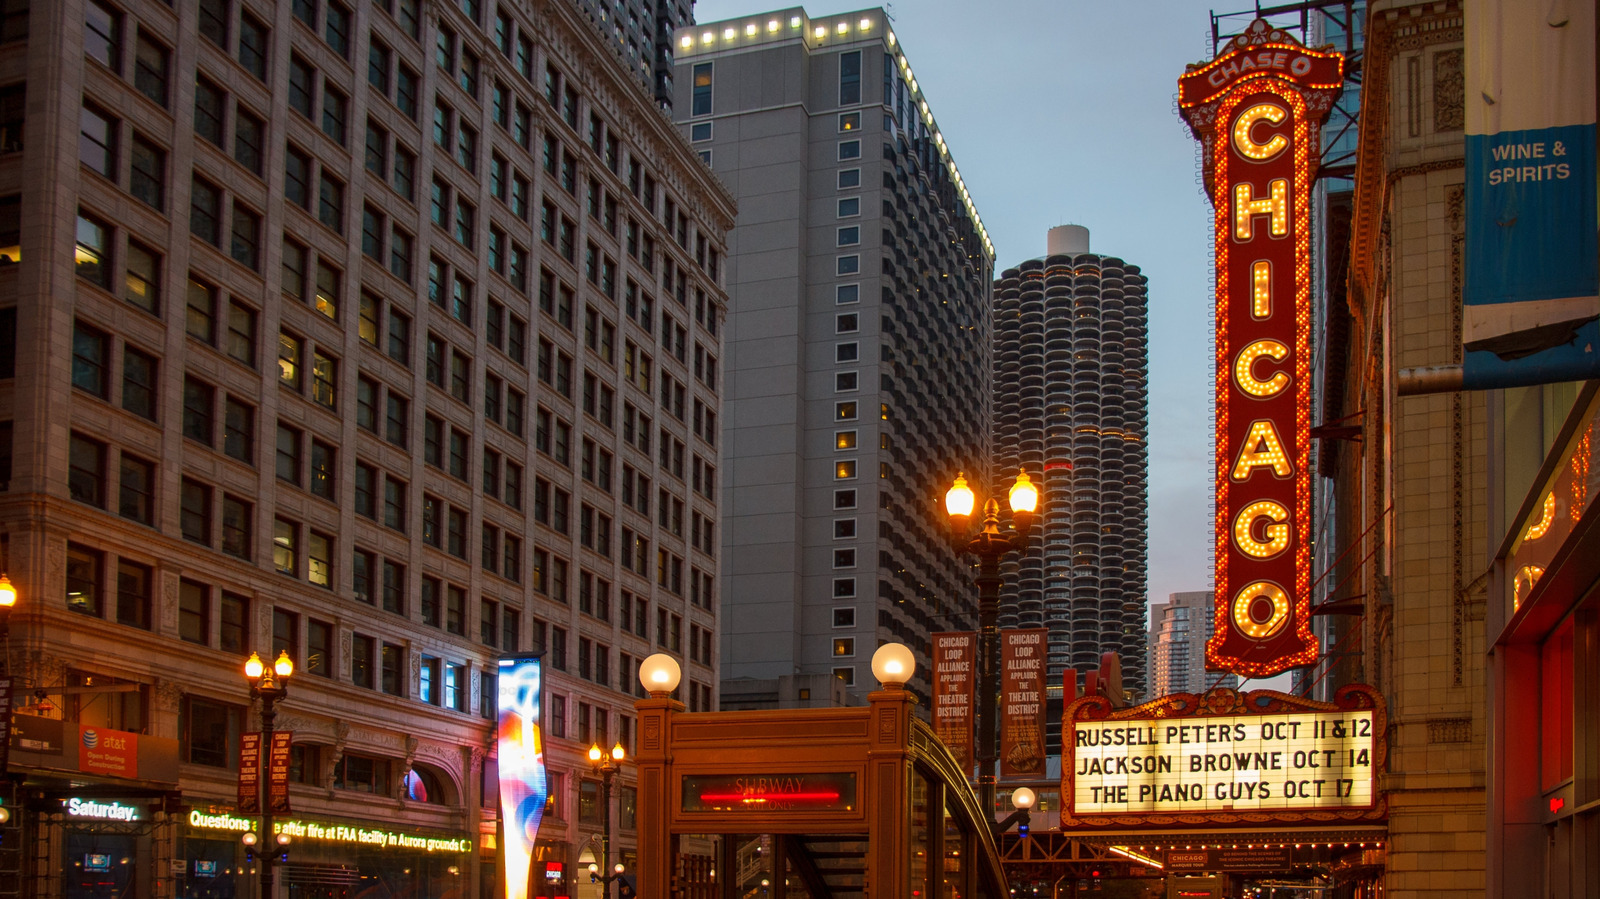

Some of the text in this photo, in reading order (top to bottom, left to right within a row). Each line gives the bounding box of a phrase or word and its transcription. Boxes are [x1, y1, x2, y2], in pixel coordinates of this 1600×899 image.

[1208, 53, 1288, 88] CHASE
[1492, 140, 1567, 162] WINE &
[1489, 163, 1571, 186] SPIRITS
[1232, 105, 1292, 639] CHICAGO
[939, 637, 969, 648] CHICAGO
[1008, 634, 1040, 645] CHICAGO
[945, 649, 963, 660] LOOP
[1015, 646, 1034, 657] LOOP
[937, 661, 970, 673] ALLIANCE
[1007, 659, 1041, 670] ALLIANCE
[948, 684, 958, 692] THE
[1019, 681, 1029, 689] THE
[938, 694, 968, 705] THEATRE
[1008, 691, 1039, 703] THEATRE
[937, 706, 969, 718] DISTRICT
[1007, 703, 1040, 715] DISTRICT
[1075, 727, 1159, 747] RUSSELL
[1166, 723, 1247, 744] PETERS
[1261, 721, 1302, 741] OCT
[103, 735, 126, 751] at&t
[87, 751, 125, 765] Open During
[1077, 748, 1370, 776] JACKSON BROWNE OCT 14
[88, 760, 126, 771] Construction
[735, 777, 805, 793] SUBWAY
[1089, 778, 1354, 804] THE PIANO GUYS OCT 17
[69, 798, 138, 822] Saturday.
[190, 810, 251, 831] Questions
[282, 821, 306, 836] after
[307, 823, 325, 839] fire
[325, 827, 336, 840] at
[336, 827, 357, 842] FAA
[358, 829, 388, 848] facility
[388, 832, 398, 846] in
[398, 833, 427, 848] Aurora
[427, 838, 460, 852] grounds
